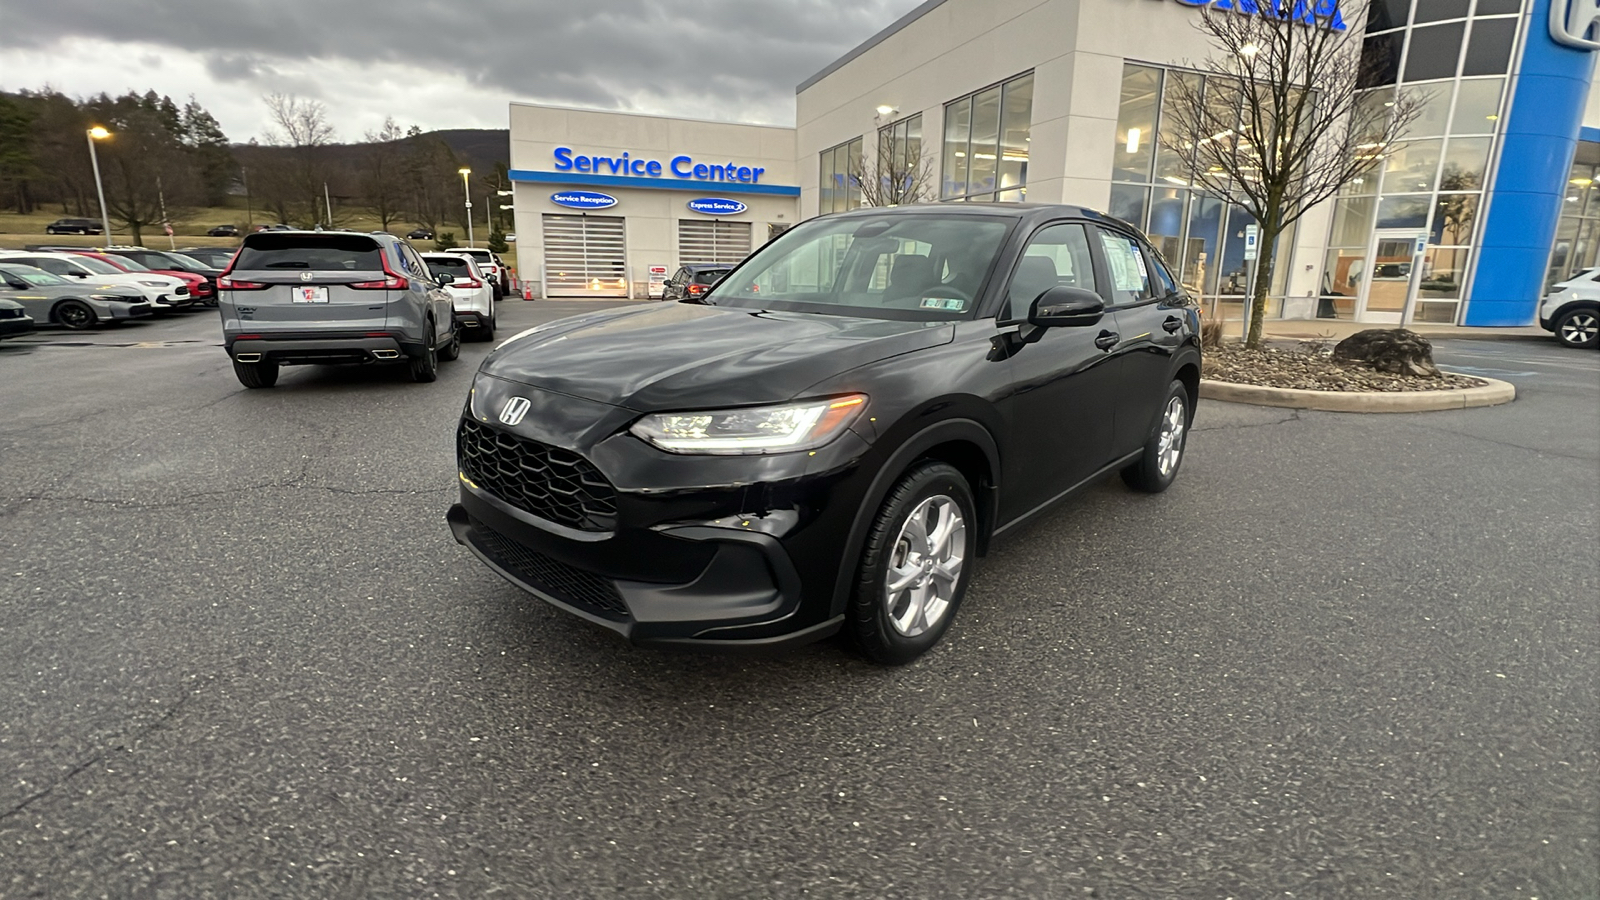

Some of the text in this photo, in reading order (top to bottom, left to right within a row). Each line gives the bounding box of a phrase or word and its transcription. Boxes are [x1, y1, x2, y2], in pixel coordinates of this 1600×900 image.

[554, 147, 765, 183] Service Center
[554, 194, 613, 204] Service Reception
[690, 202, 735, 210] Express Service
